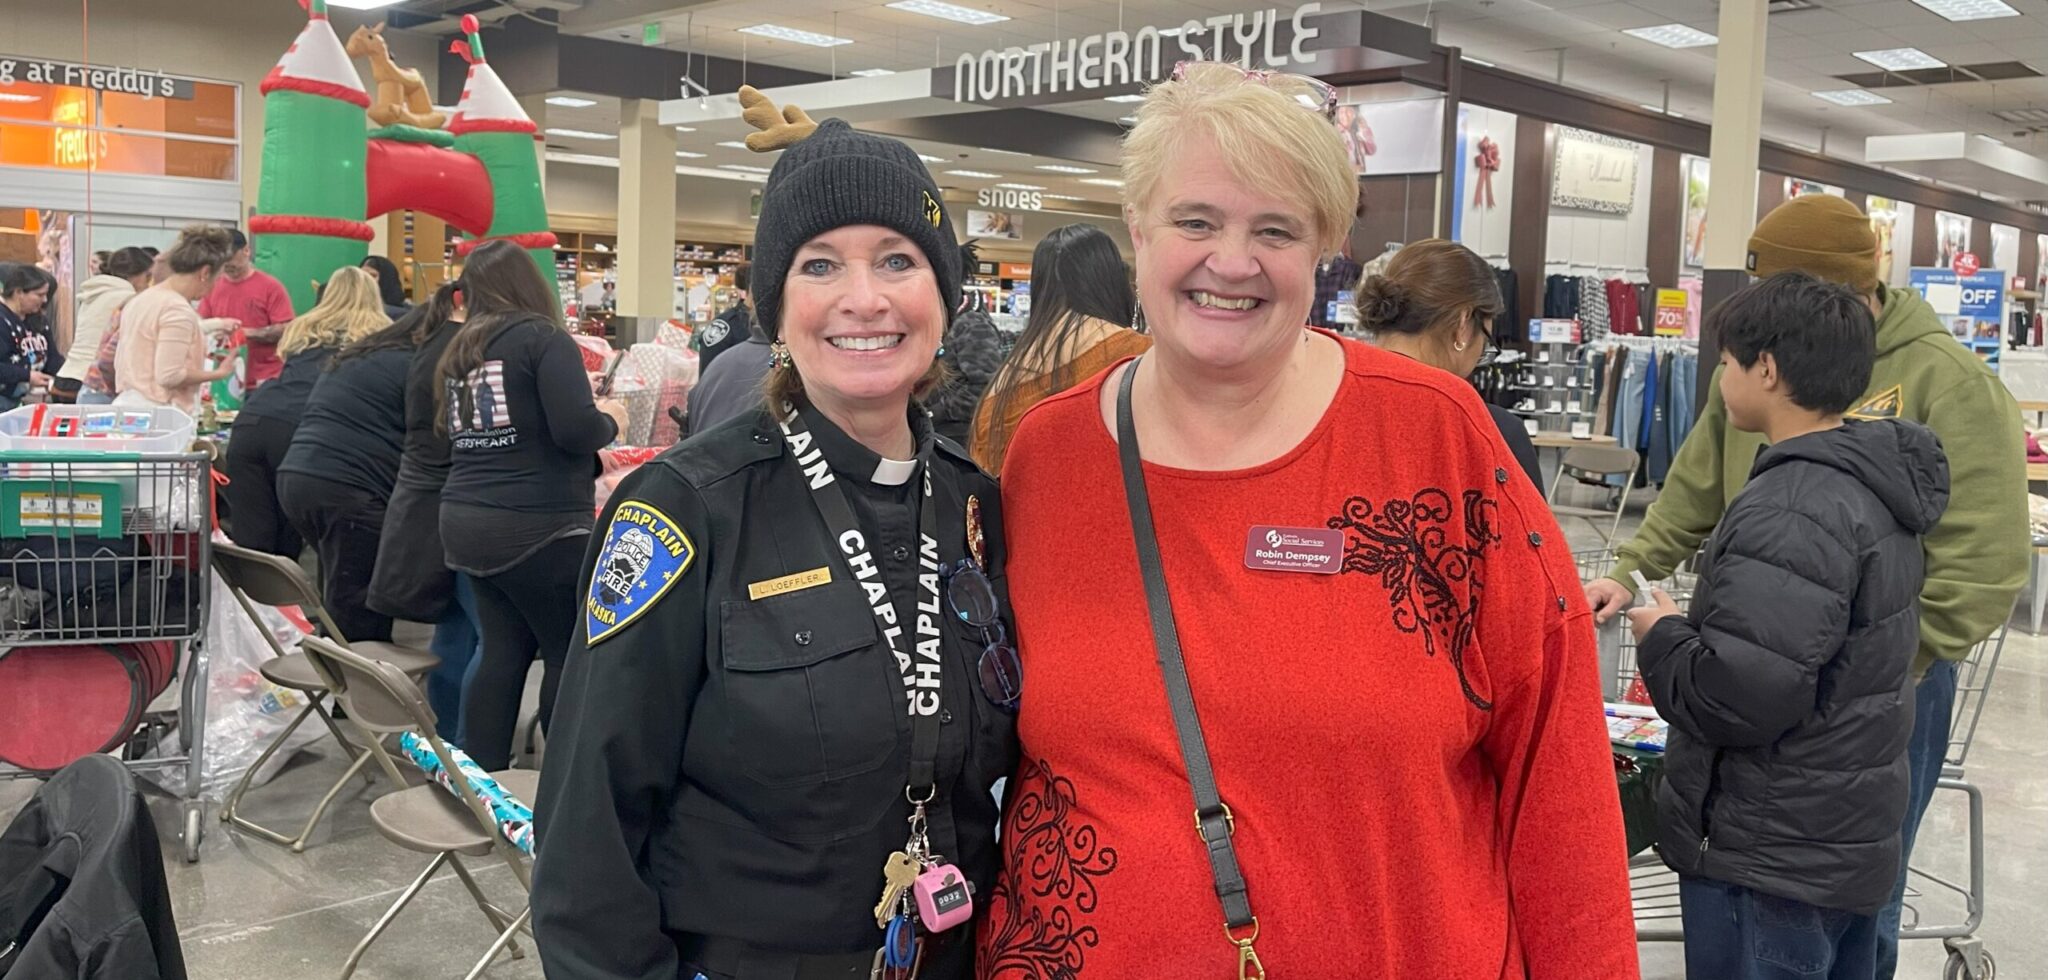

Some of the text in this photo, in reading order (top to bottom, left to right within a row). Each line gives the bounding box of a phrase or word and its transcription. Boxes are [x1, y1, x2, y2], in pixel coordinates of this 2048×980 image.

[955, 3, 1321, 103] NORTHERN STYLE
[27, 63, 54, 83] at
[65, 67, 175, 99] Freddy's
[1961, 289, 1997, 304] OFF
[617, 508, 685, 558] CHAPLAIN
[616, 542, 648, 567] POLICE
[1255, 549, 1331, 564] Robin Dempsey
[602, 572, 630, 596] FIRE
[770, 573, 819, 592] LOEFFLER
[589, 598, 615, 625] ALASKA
[916, 532, 940, 716] CHAPLAIN
